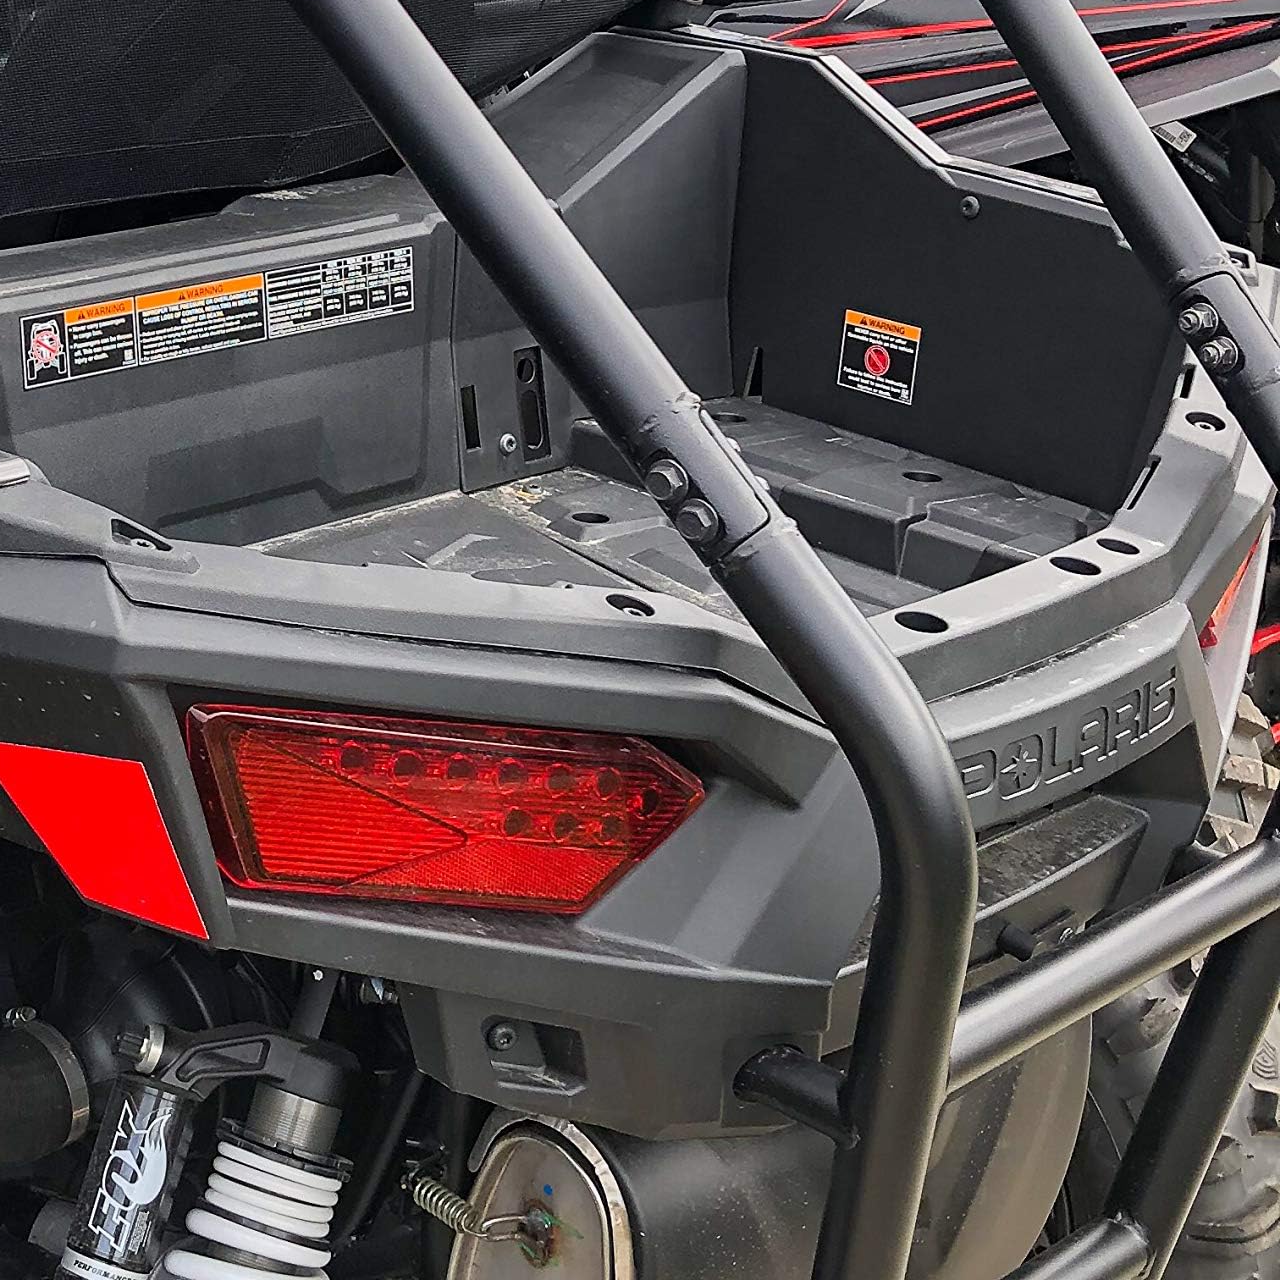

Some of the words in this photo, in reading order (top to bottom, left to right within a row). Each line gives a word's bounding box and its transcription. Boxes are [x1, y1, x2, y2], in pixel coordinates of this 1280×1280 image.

[187, 284, 224, 299] WARNING
[86, 303, 126, 318] WARNING
[868, 318, 906, 336] WARNING
[952, 666, 1178, 801] POLARIS
[87, 1098, 172, 1254] FOX
